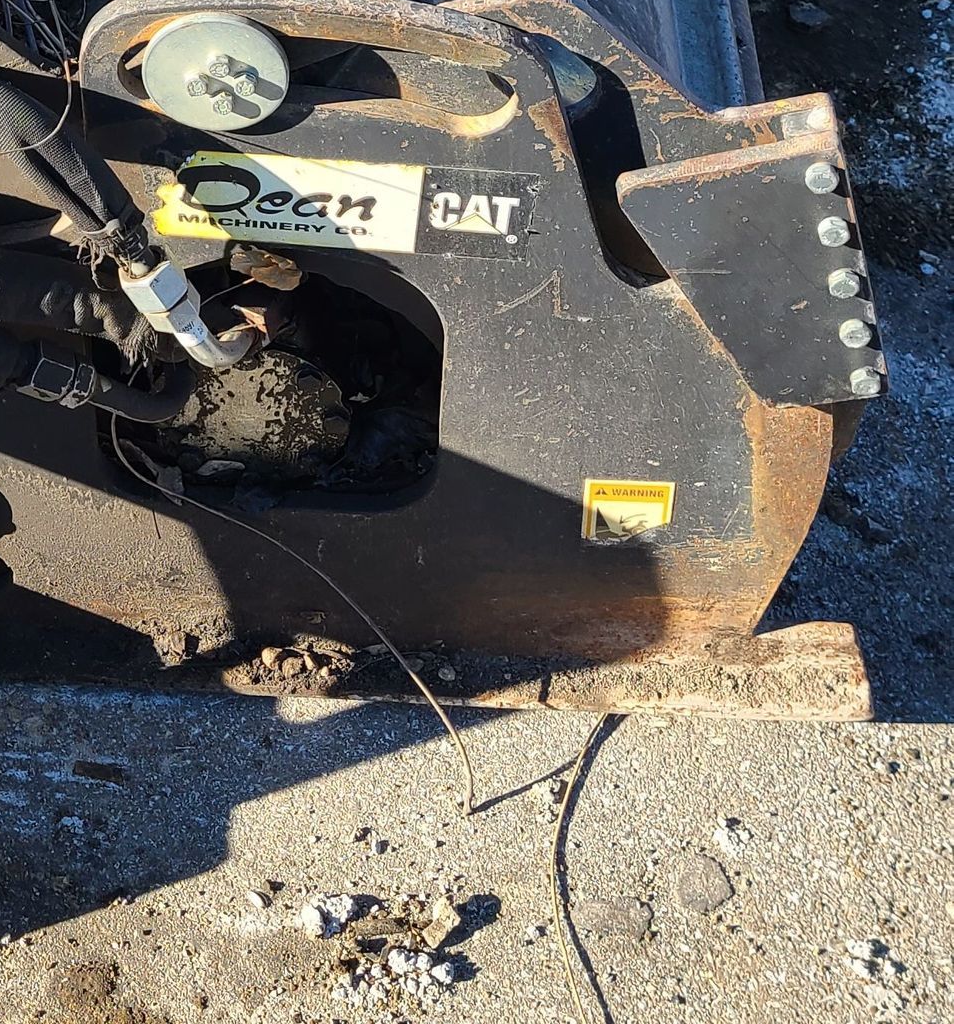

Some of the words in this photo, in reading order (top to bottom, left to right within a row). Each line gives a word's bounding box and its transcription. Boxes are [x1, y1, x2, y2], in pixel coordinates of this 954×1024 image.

[177, 161, 378, 222] Dean
[178, 213, 328, 235] MACHINERY
[430, 191, 521, 236] CAT
[611, 488, 665, 498] WARNING
